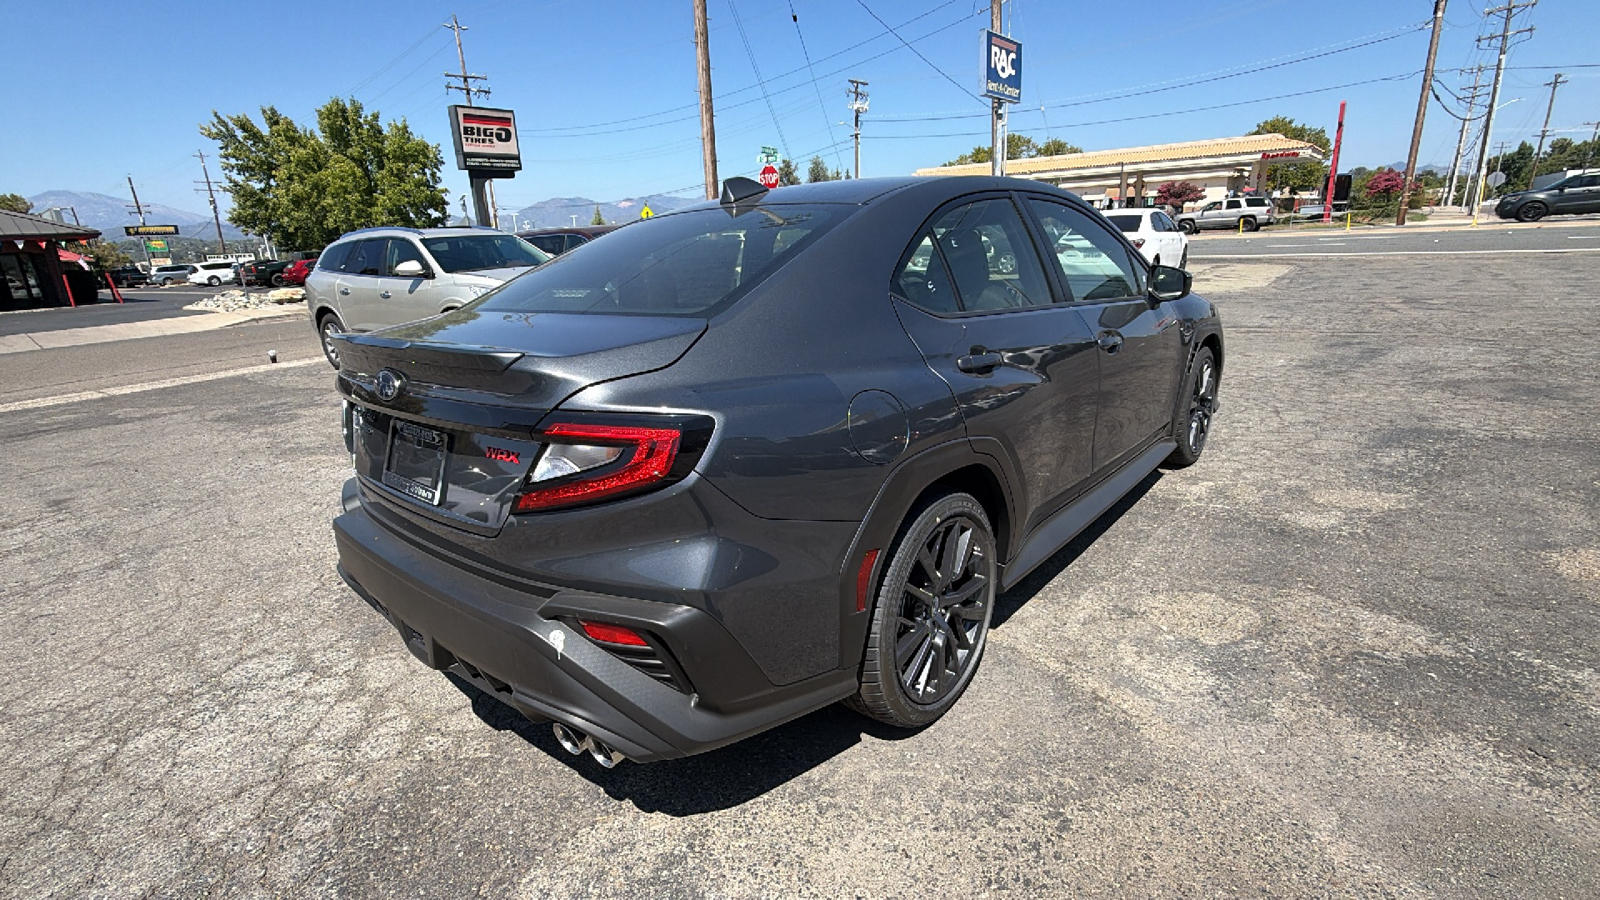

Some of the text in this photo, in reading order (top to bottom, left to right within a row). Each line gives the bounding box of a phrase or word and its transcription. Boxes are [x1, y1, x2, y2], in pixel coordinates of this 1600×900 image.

[991, 44, 1016, 78] RAC
[463, 126, 494, 137] BIG
[760, 173, 778, 185] STOP
[486, 446, 520, 465] WRX
